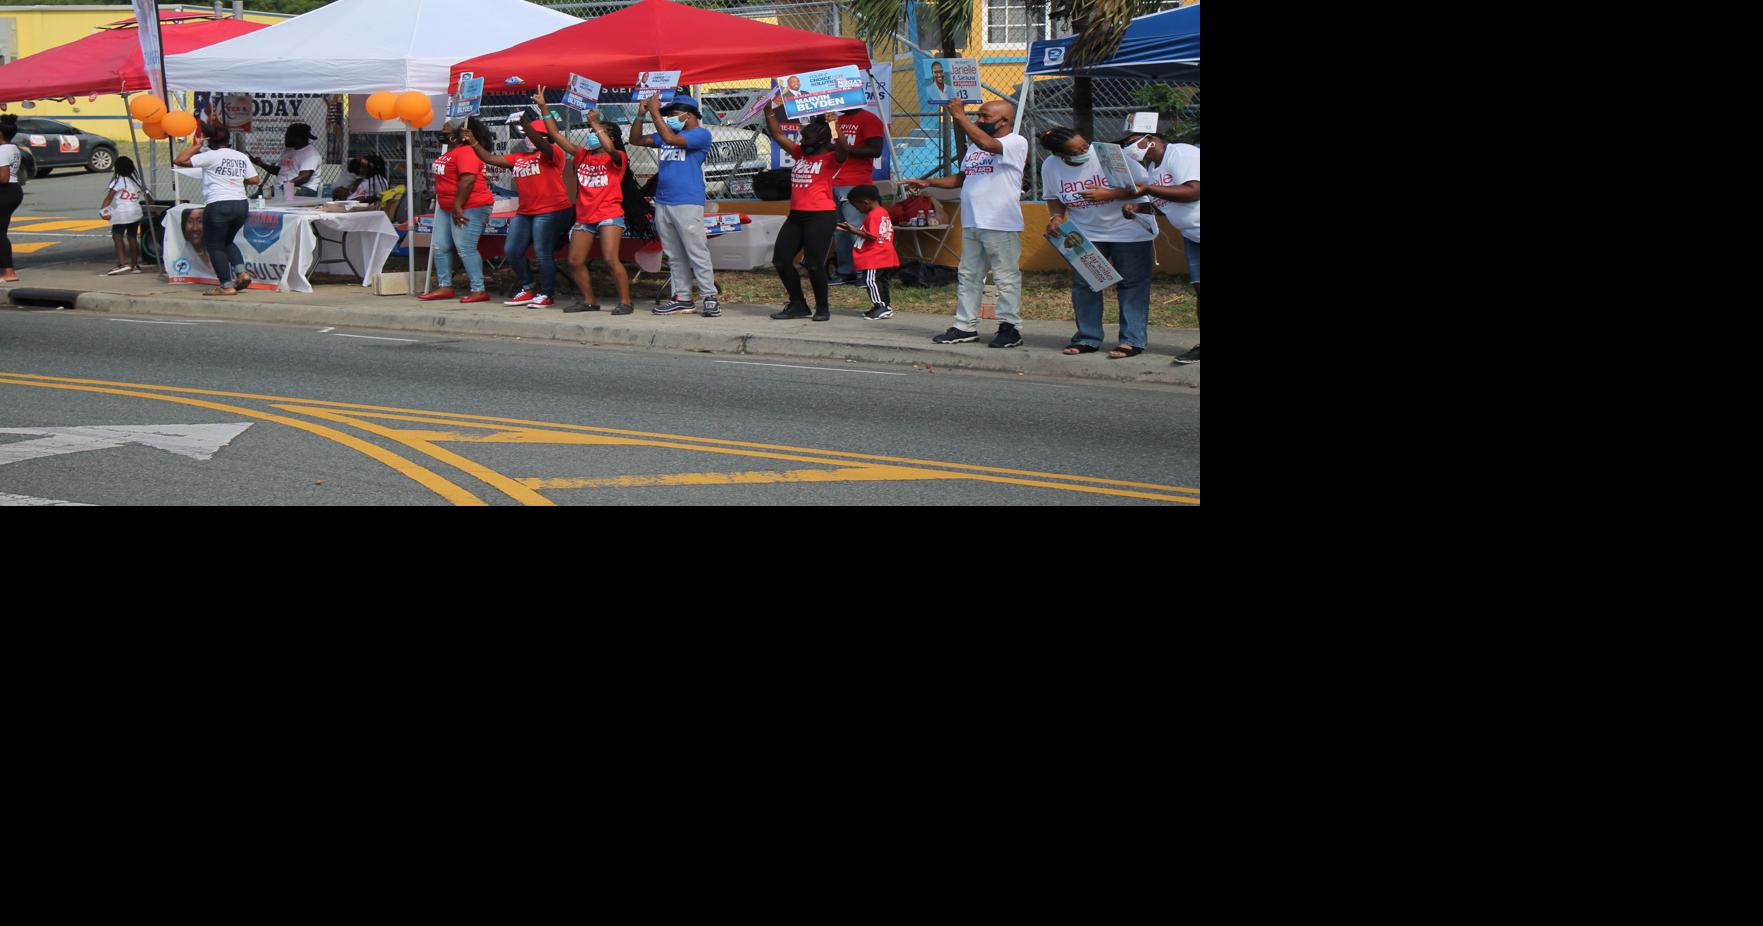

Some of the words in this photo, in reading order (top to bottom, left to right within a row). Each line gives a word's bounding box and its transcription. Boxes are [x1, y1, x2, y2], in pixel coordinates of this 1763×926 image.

[865, 81, 886, 90] FR
[794, 94, 830, 105] MARVIN
[796, 97, 845, 112] BLYDEN
[251, 99, 302, 116] ODAY
[221, 158, 247, 169] PROVEN
[215, 166, 247, 178] RESULTS
[1059, 175, 1111, 194] Janelle
[231, 262, 287, 281] RSULTS
